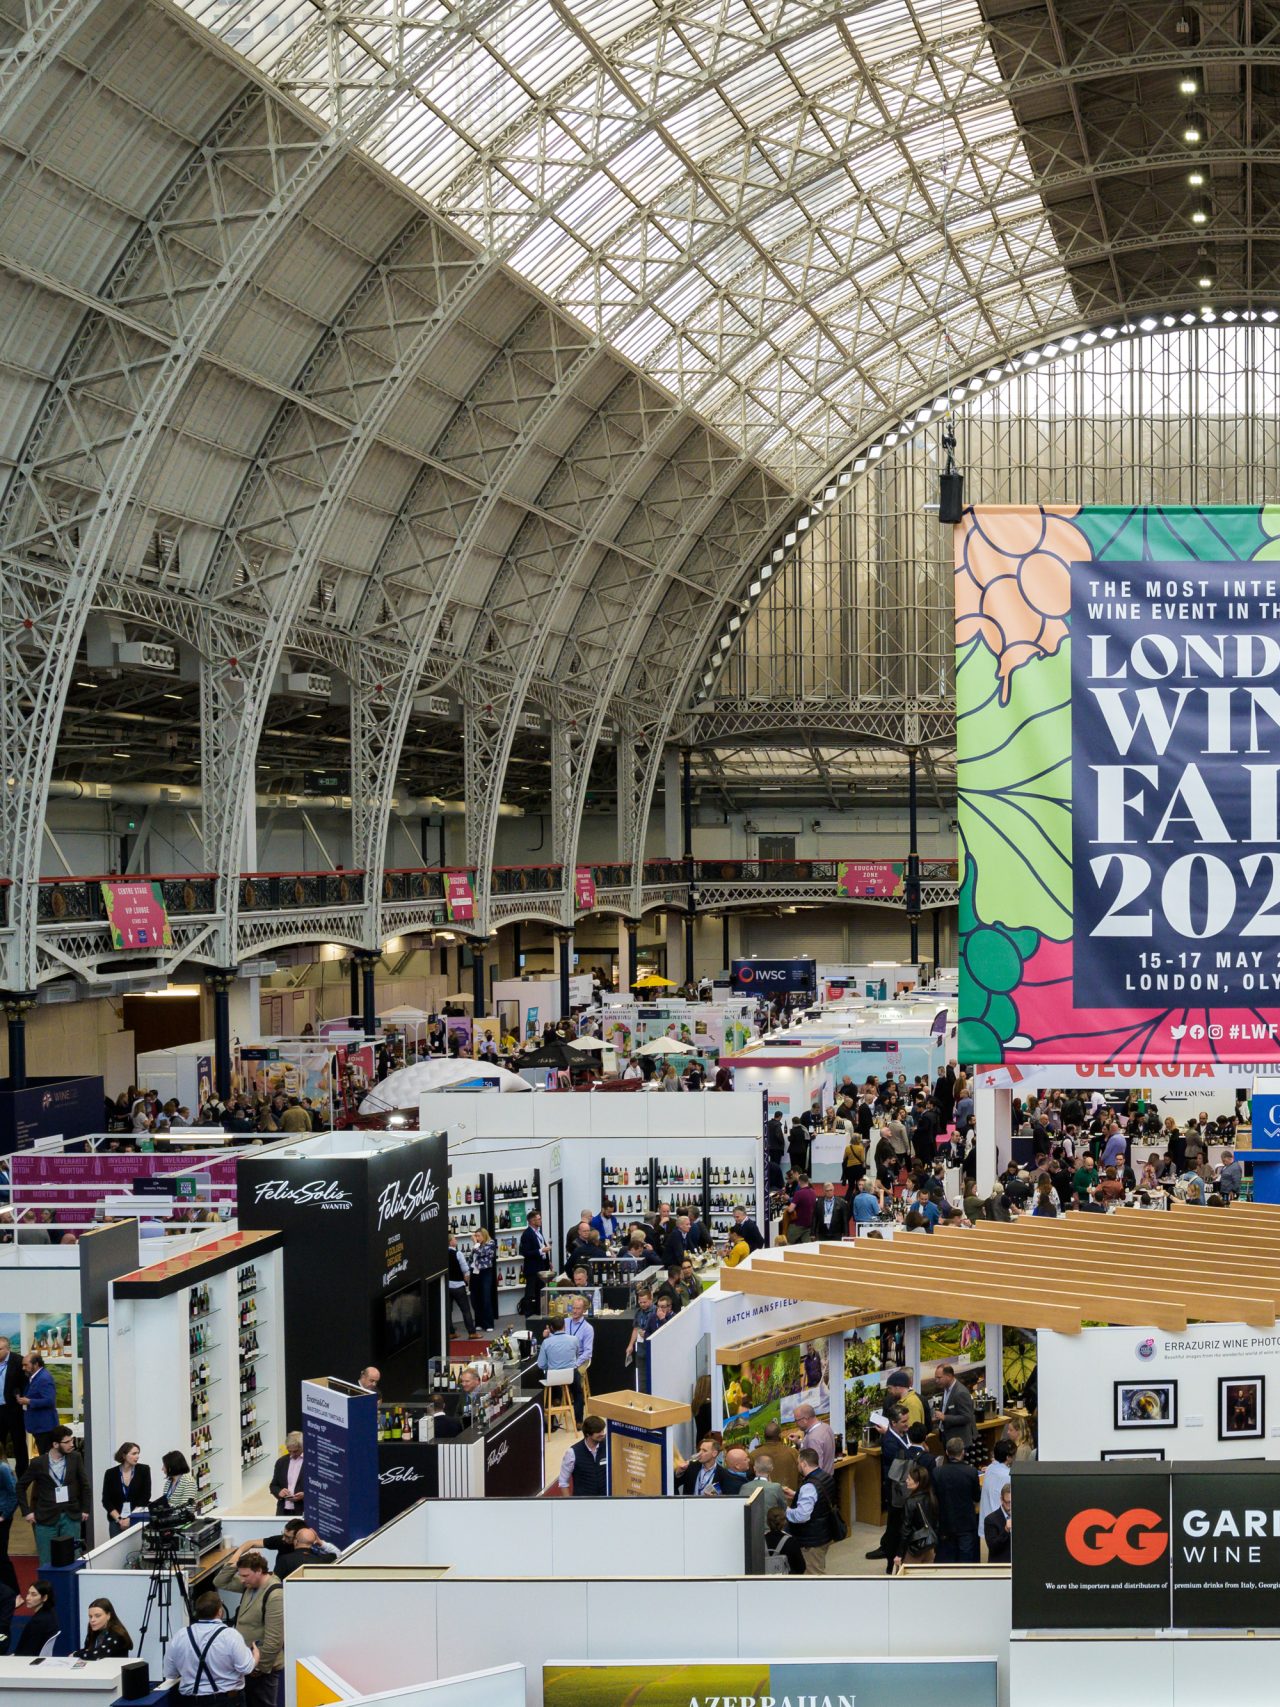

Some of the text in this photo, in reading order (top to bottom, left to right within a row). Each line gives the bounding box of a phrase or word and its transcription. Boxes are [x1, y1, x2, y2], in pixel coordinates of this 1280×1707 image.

[1088, 580, 1132, 598] THE
[1146, 580, 1210, 598] MOST
[1087, 602, 1141, 620] WINE
[1151, 602, 1218, 620] EVENT
[1228, 602, 1249, 619] IN
[1138, 952, 1202, 969] 15-17
[1216, 951, 1263, 968] MAY
[755, 970, 786, 980] IWSC
[1126, 973, 1229, 993] LONDON,
[1075, 1063, 1215, 1078] GEORGIA
[53, 1157, 88, 1165] INVERARITY
[58, 1167, 84, 1175] MORTON
[113, 1166, 139, 1174] MORTON
[420, 1209, 439, 1223] AVANTIS
[726, 1299, 798, 1325] HATCH MANSFIELD
[1164, 1339, 1220, 1351] ERRAZURIZ
[1222, 1338, 1249, 1349] WINE
[1065, 1508, 1169, 1566] GG
[1183, 1546, 1261, 1563] WINE
[1079, 1582, 1110, 1591] importers
[1174, 1582, 1202, 1590] premium
[1240, 1582, 1258, 1591] Italy,
